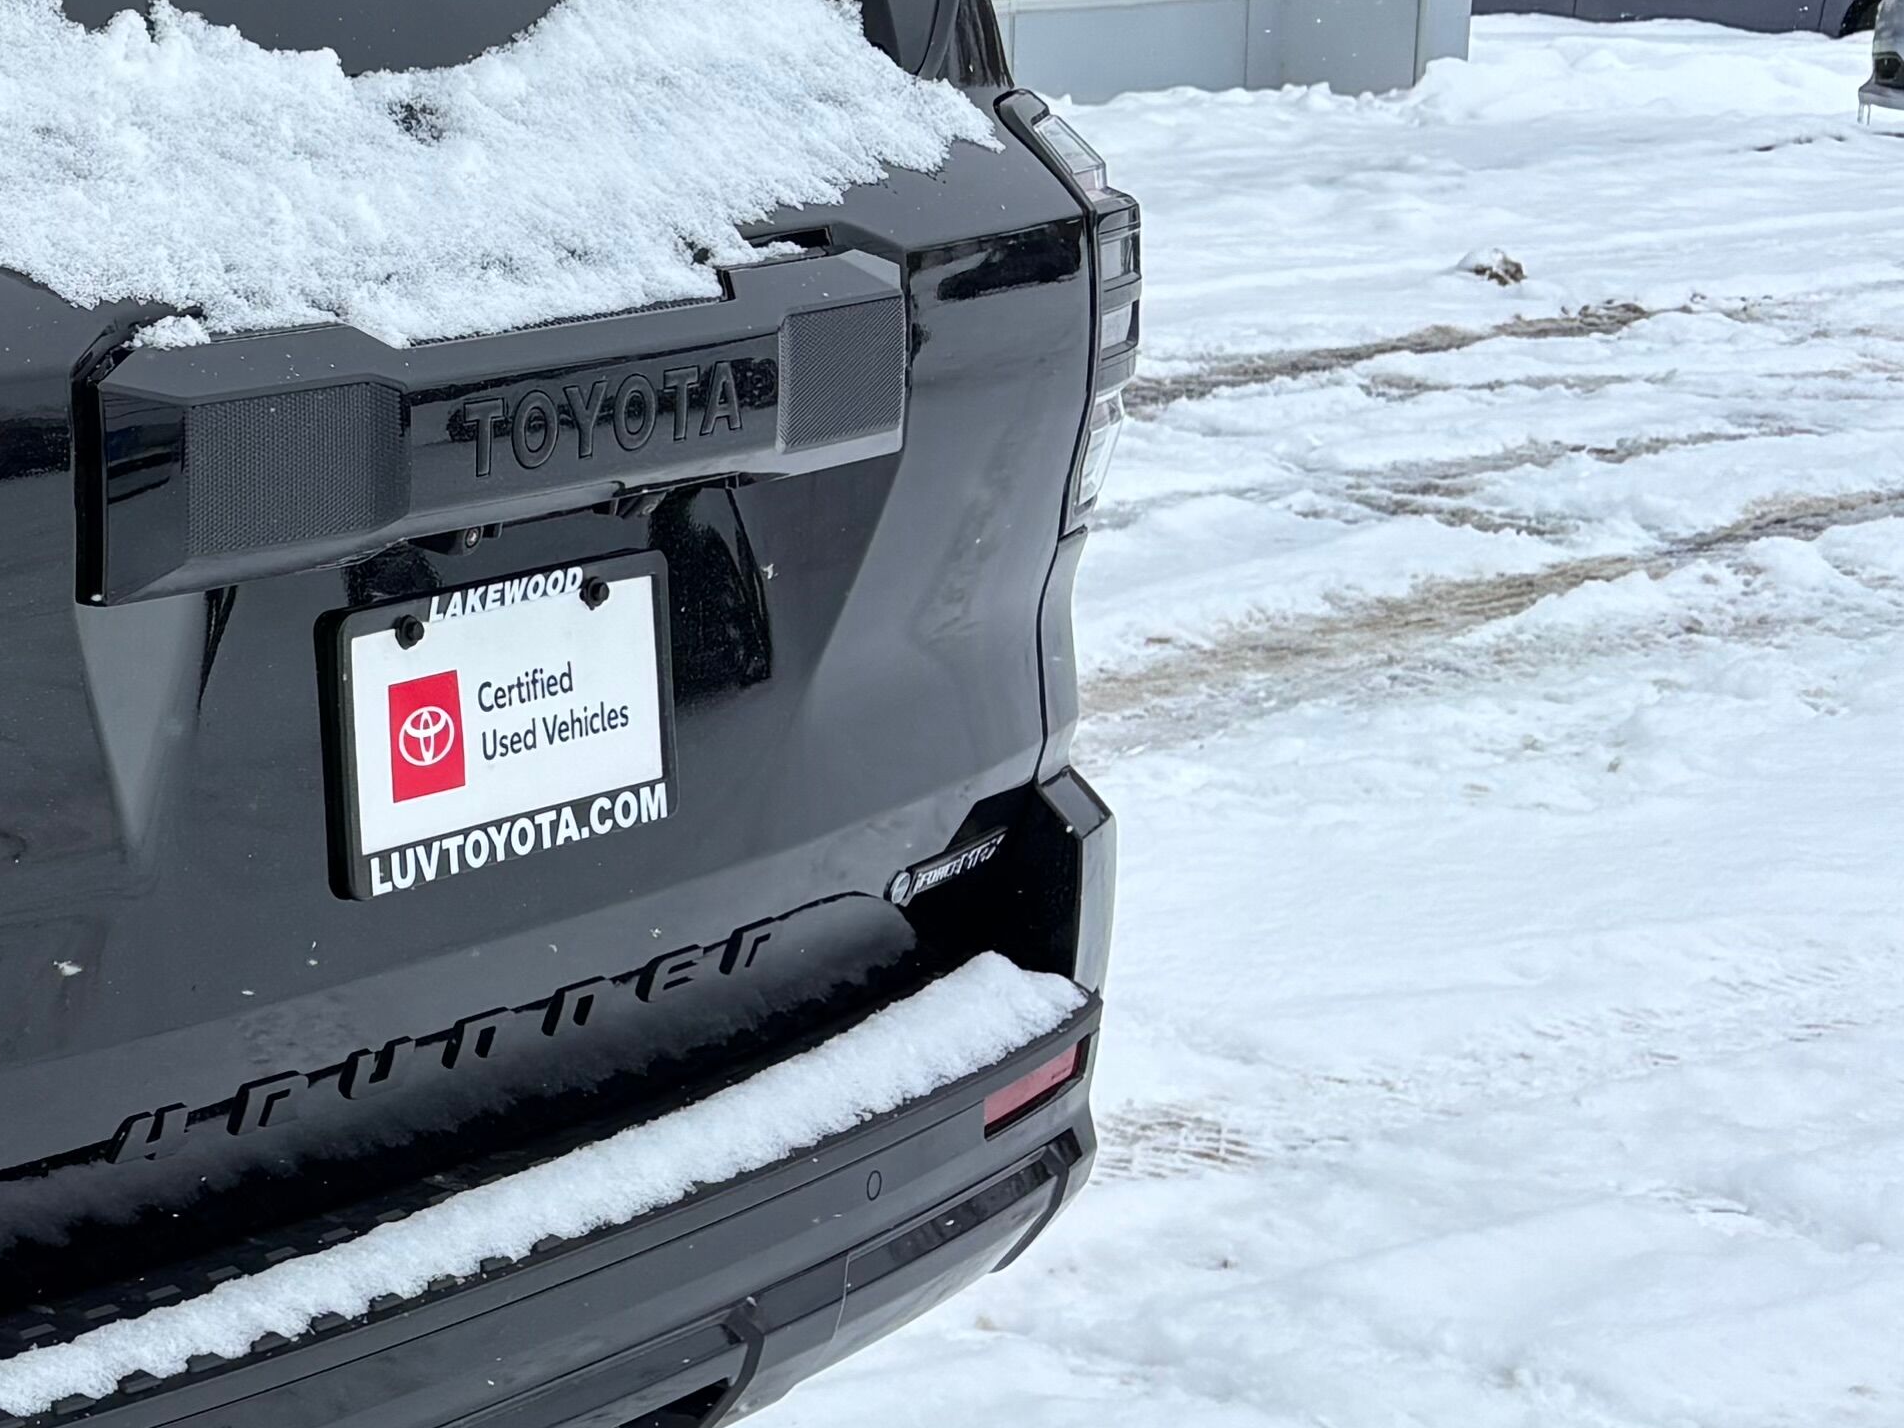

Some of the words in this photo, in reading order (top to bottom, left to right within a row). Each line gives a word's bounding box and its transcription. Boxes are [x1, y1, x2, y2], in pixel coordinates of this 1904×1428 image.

[463, 360, 744, 478] TOYOTA
[428, 566, 584, 623] LAKEWOOD
[477, 660, 574, 713] Certified
[481, 718, 537, 761] Used
[542, 701, 630, 746] Vehicles
[369, 782, 669, 897] LUVTOYOTA.COM
[108, 916, 784, 1165] 4RUNNER
